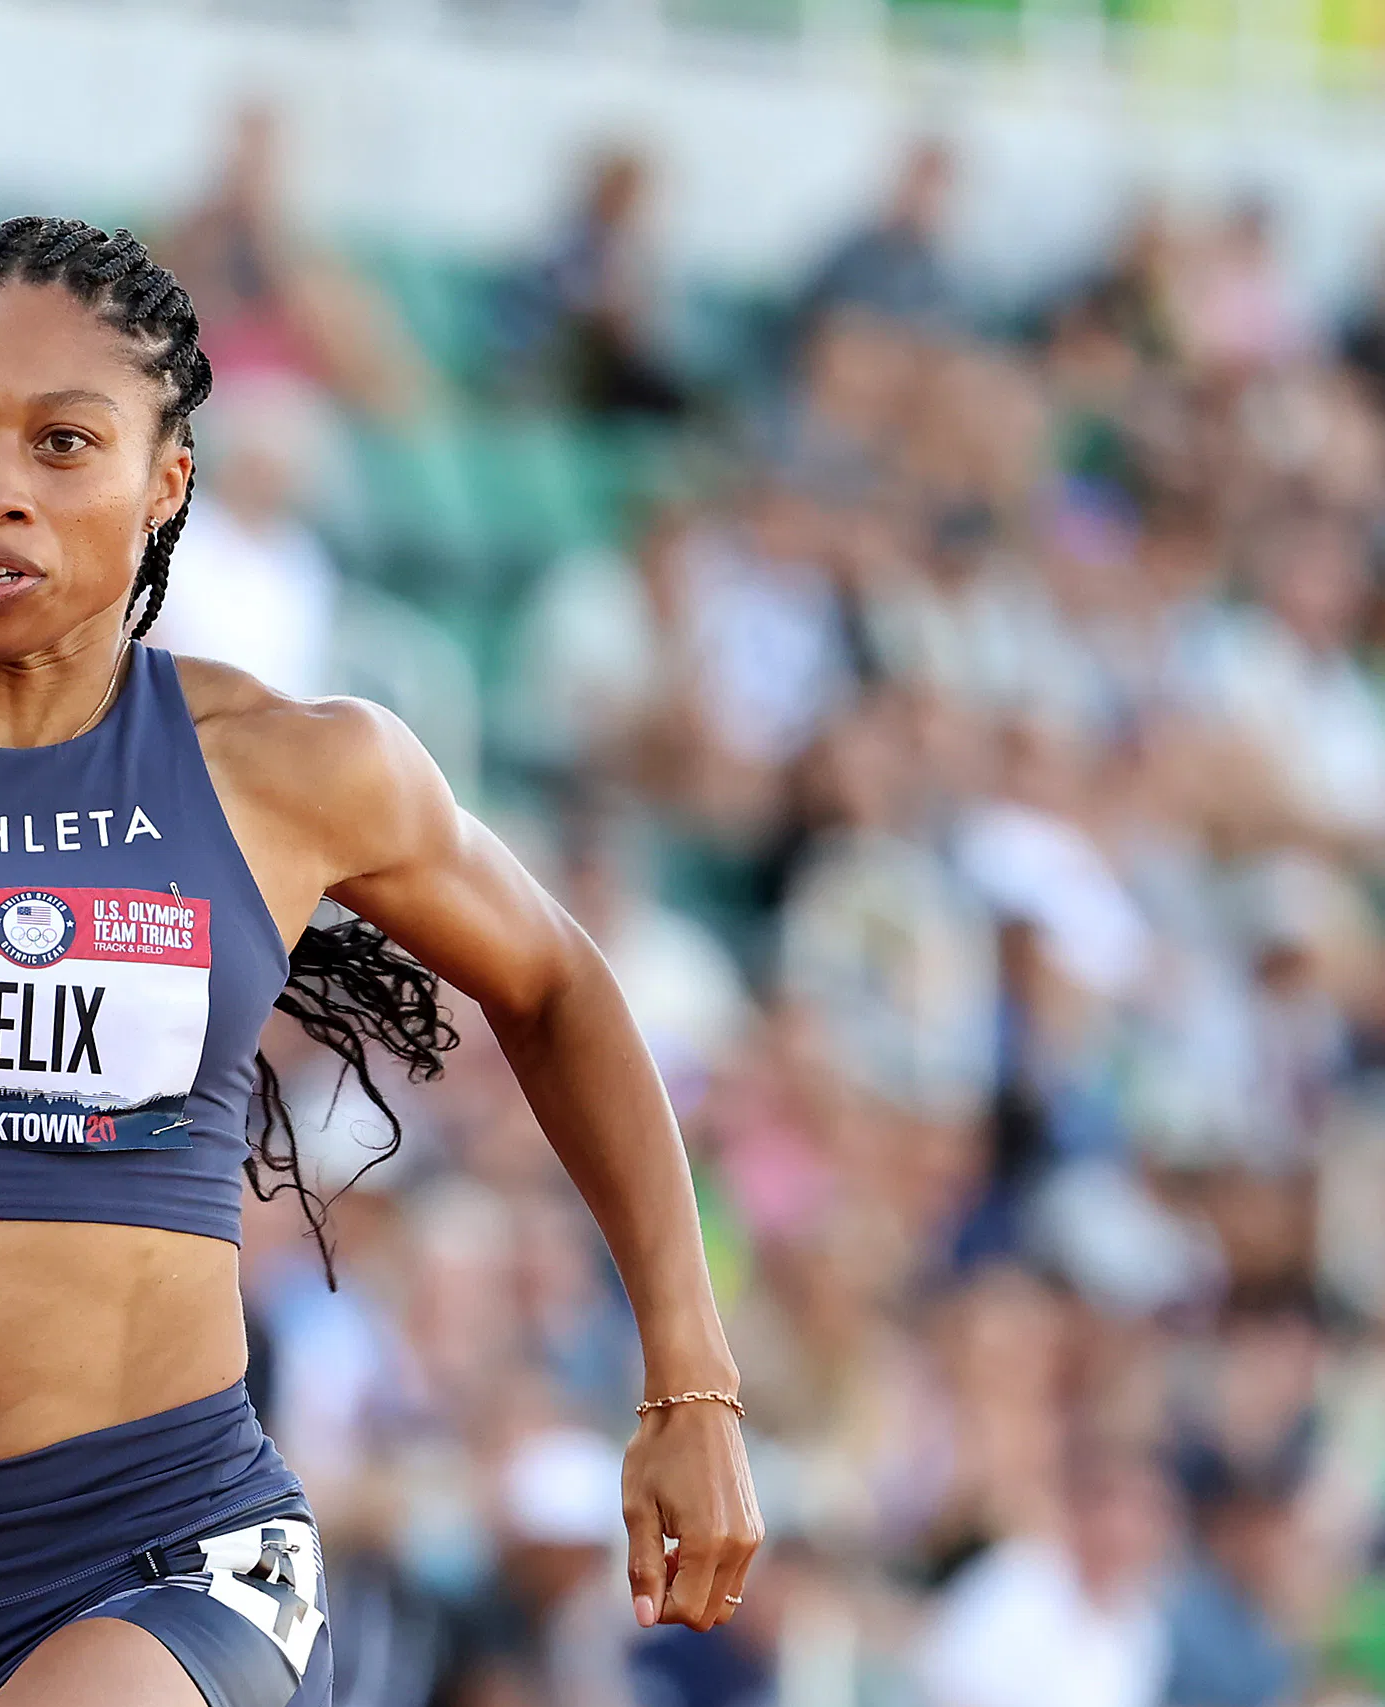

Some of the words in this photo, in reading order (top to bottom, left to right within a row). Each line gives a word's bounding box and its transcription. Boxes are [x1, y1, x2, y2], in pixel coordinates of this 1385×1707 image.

[0, 892, 32, 910] UNITED
[35, 892, 68, 912] STATES
[94, 899, 124, 920] U.S.
[128, 901, 194, 929] OLYMPIC
[93, 920, 136, 943] TEAM
[140, 923, 193, 950] TRIALS
[0, 940, 37, 964] OLYMPIC
[42, 944, 65, 963] TEAM
[93, 942, 126, 953] TRACK
[127, 944, 135, 953] &
[136, 944, 164, 955] FIELD
